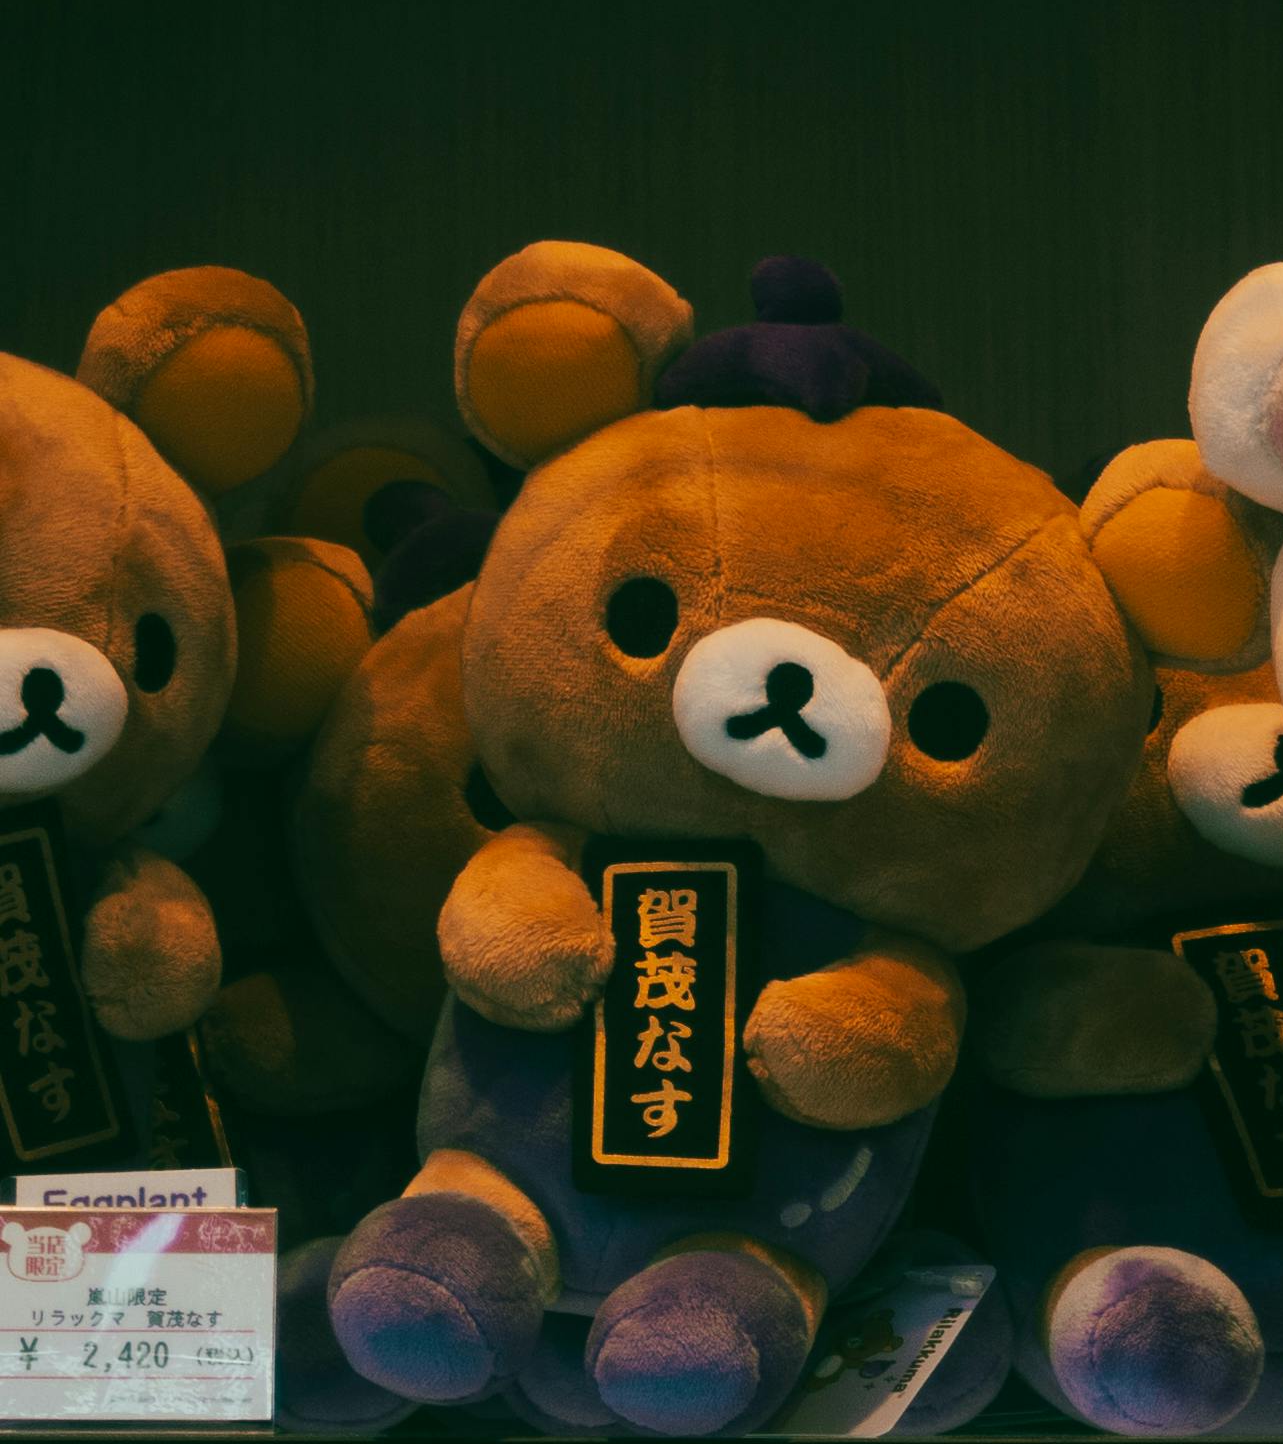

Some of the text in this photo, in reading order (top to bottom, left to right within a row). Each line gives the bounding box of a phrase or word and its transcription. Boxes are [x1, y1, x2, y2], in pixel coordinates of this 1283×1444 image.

[631, 888, 698, 1139] 賀茂なす
[32, 1311, 222, 1328] リラックマ 賀茂なす
[83, 1341, 169, 1372] 2,420
